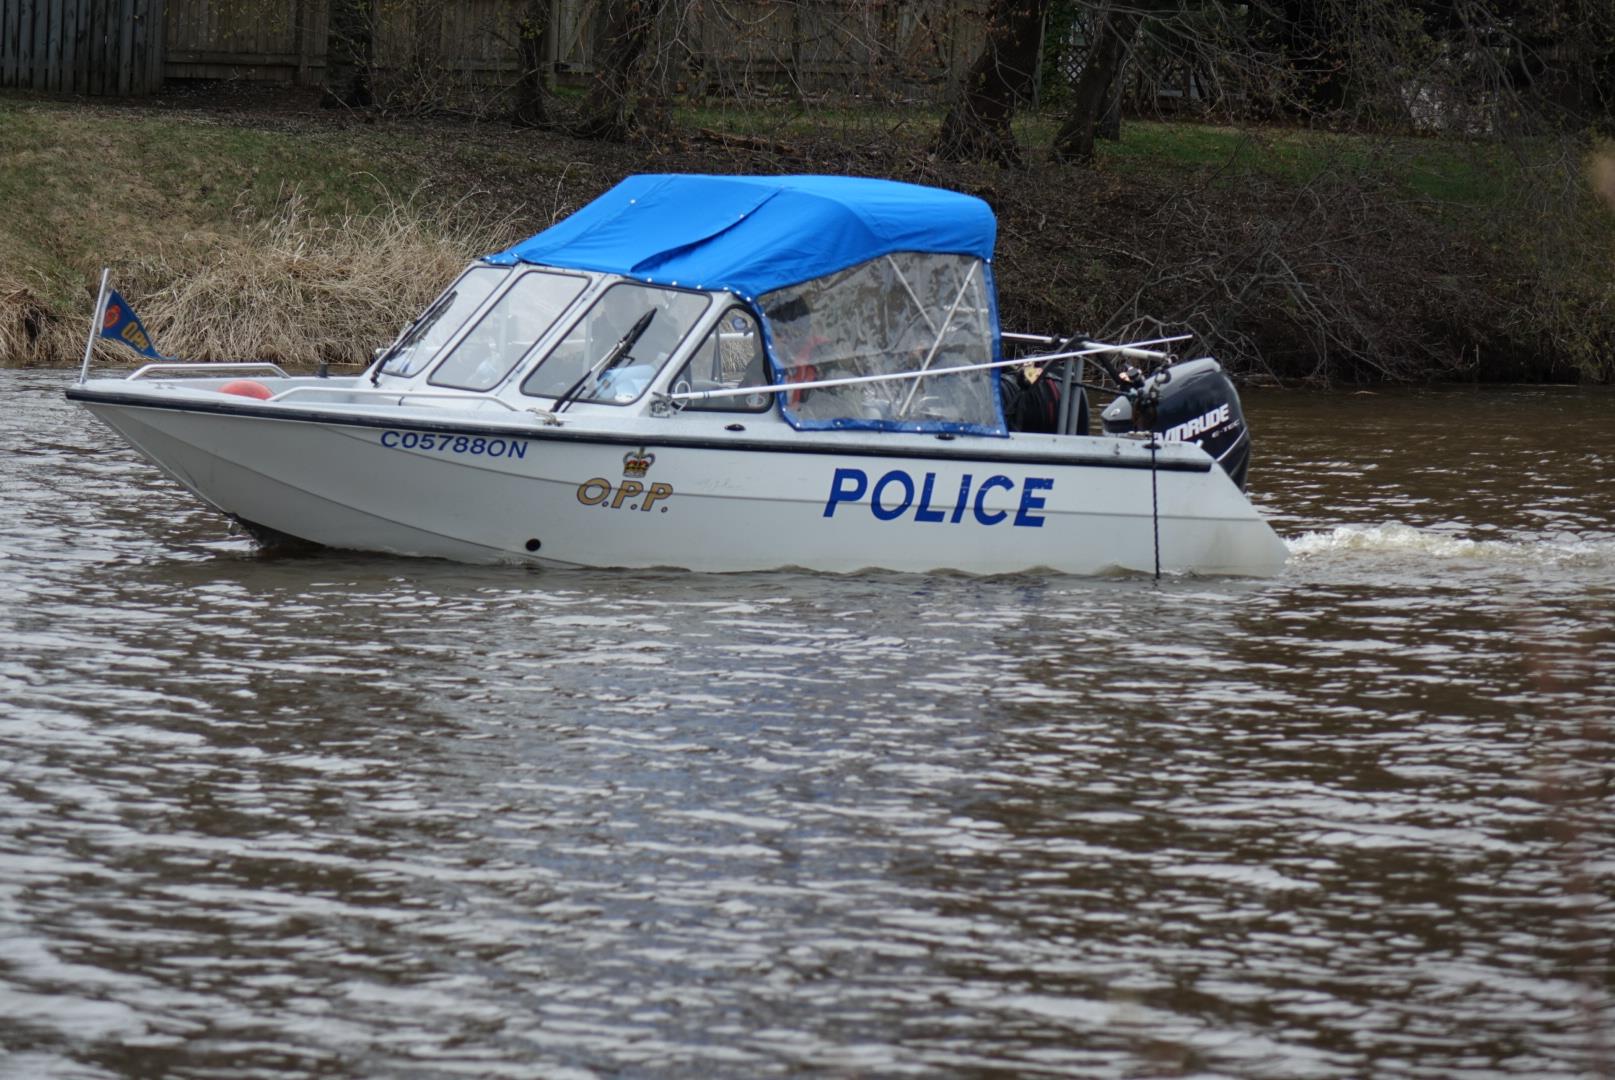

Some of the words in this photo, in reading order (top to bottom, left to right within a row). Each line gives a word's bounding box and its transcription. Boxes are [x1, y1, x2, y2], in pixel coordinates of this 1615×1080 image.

[380, 430, 528, 459] C05788ON
[576, 477, 674, 513] O.P.P.
[822, 467, 1054, 527] POLICE
